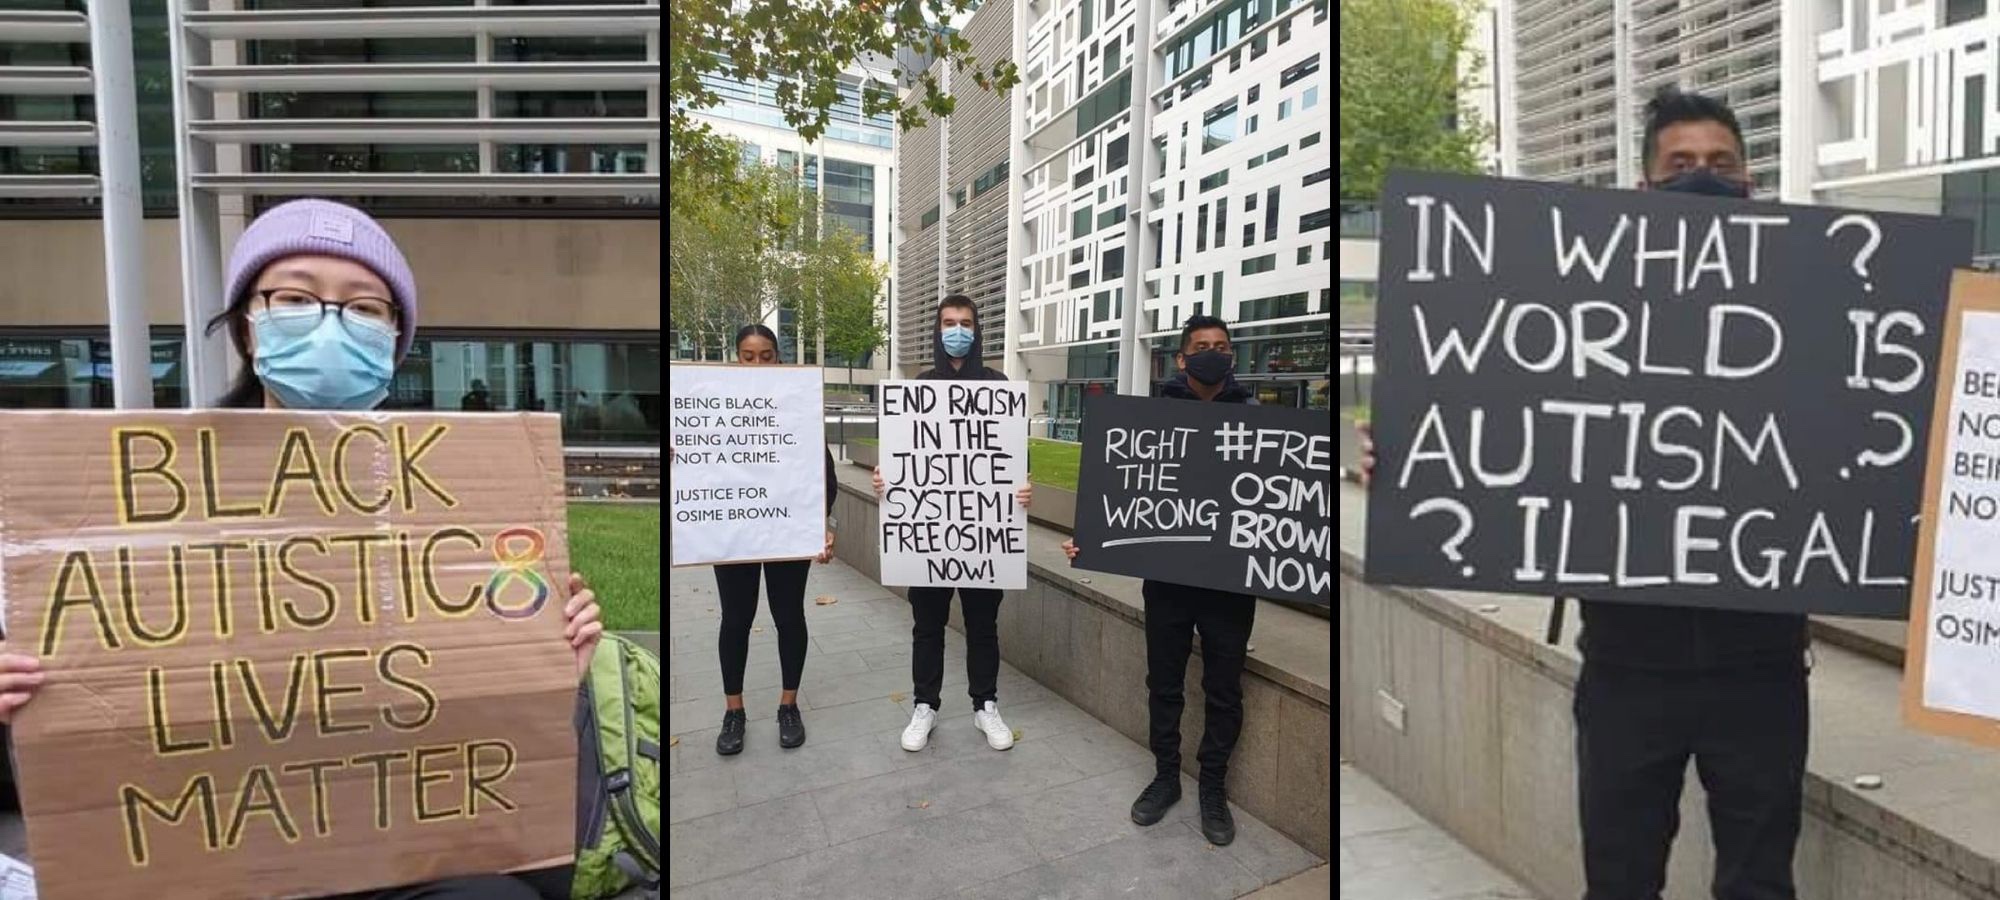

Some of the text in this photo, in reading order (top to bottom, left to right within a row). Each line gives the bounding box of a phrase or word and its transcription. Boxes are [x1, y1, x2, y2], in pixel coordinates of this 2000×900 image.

[1406, 195, 1496, 281] IN
[1552, 207, 1790, 294] WHAT
[1413, 298, 1926, 393] WORLD IS
[674, 397, 778, 410] BEING BLACK.
[883, 384, 1027, 418] END RACISM
[674, 415, 780, 428] NOT A CRIME.
[912, 418, 1004, 451] IN THE
[675, 433, 797, 446] BEING AUTISTIC.
[1105, 427, 1199, 463] RIGHT
[1398, 401, 1800, 492] AUTISM
[676, 451, 781, 464] NOT A CRIME.
[889, 452, 1014, 487] JUSTICE
[113, 423, 459, 528] BLACK
[1116, 463, 1181, 493] THE
[675, 487, 768, 505] JUSTICE FOR
[885, 487, 1014, 524] SYSTEM!
[1231, 472, 1330, 518] OSIM
[676, 506, 791, 522] OSIME BROWN.
[1103, 495, 1220, 531] WRONG
[883, 522, 1025, 554] FREE OSIME
[1230, 510, 1330, 561] BROW
[1515, 496, 1920, 590] ILLEGAL
[926, 557, 995, 584] NOW!
[147, 643, 440, 756] LIVES
[119, 739, 519, 867] MATTER
